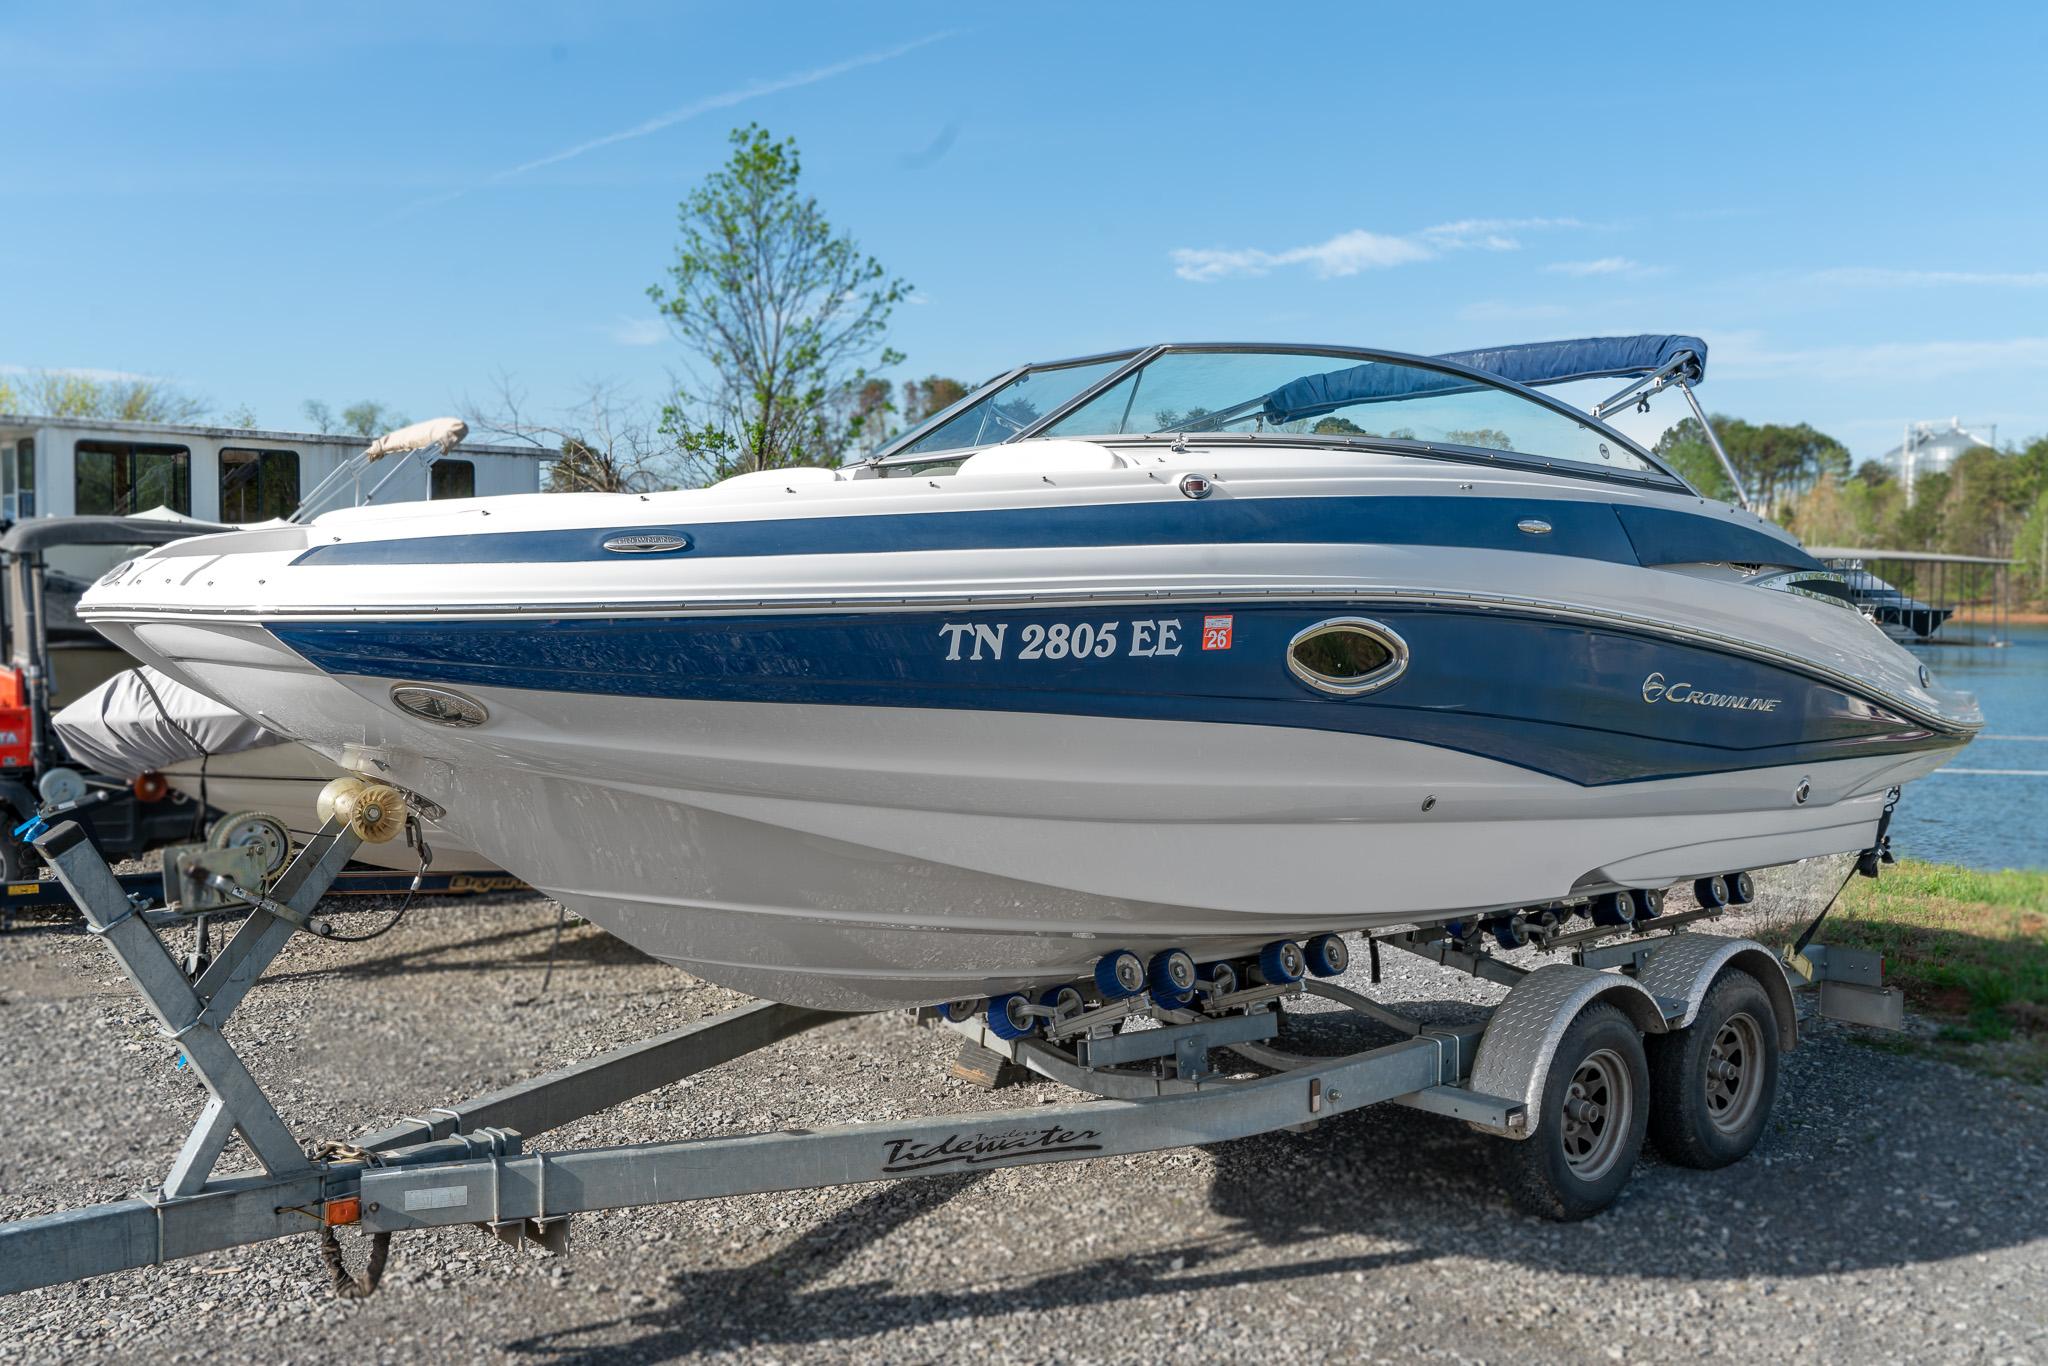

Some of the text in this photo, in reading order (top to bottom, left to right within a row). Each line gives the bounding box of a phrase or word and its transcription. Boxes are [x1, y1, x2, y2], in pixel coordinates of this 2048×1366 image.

[938, 618, 1183, 661] TN 2805 EE
[1207, 629, 1227, 649] 26
[448, 875, 531, 893] Bryan
[883, 1125, 1102, 1165] Tidewater
